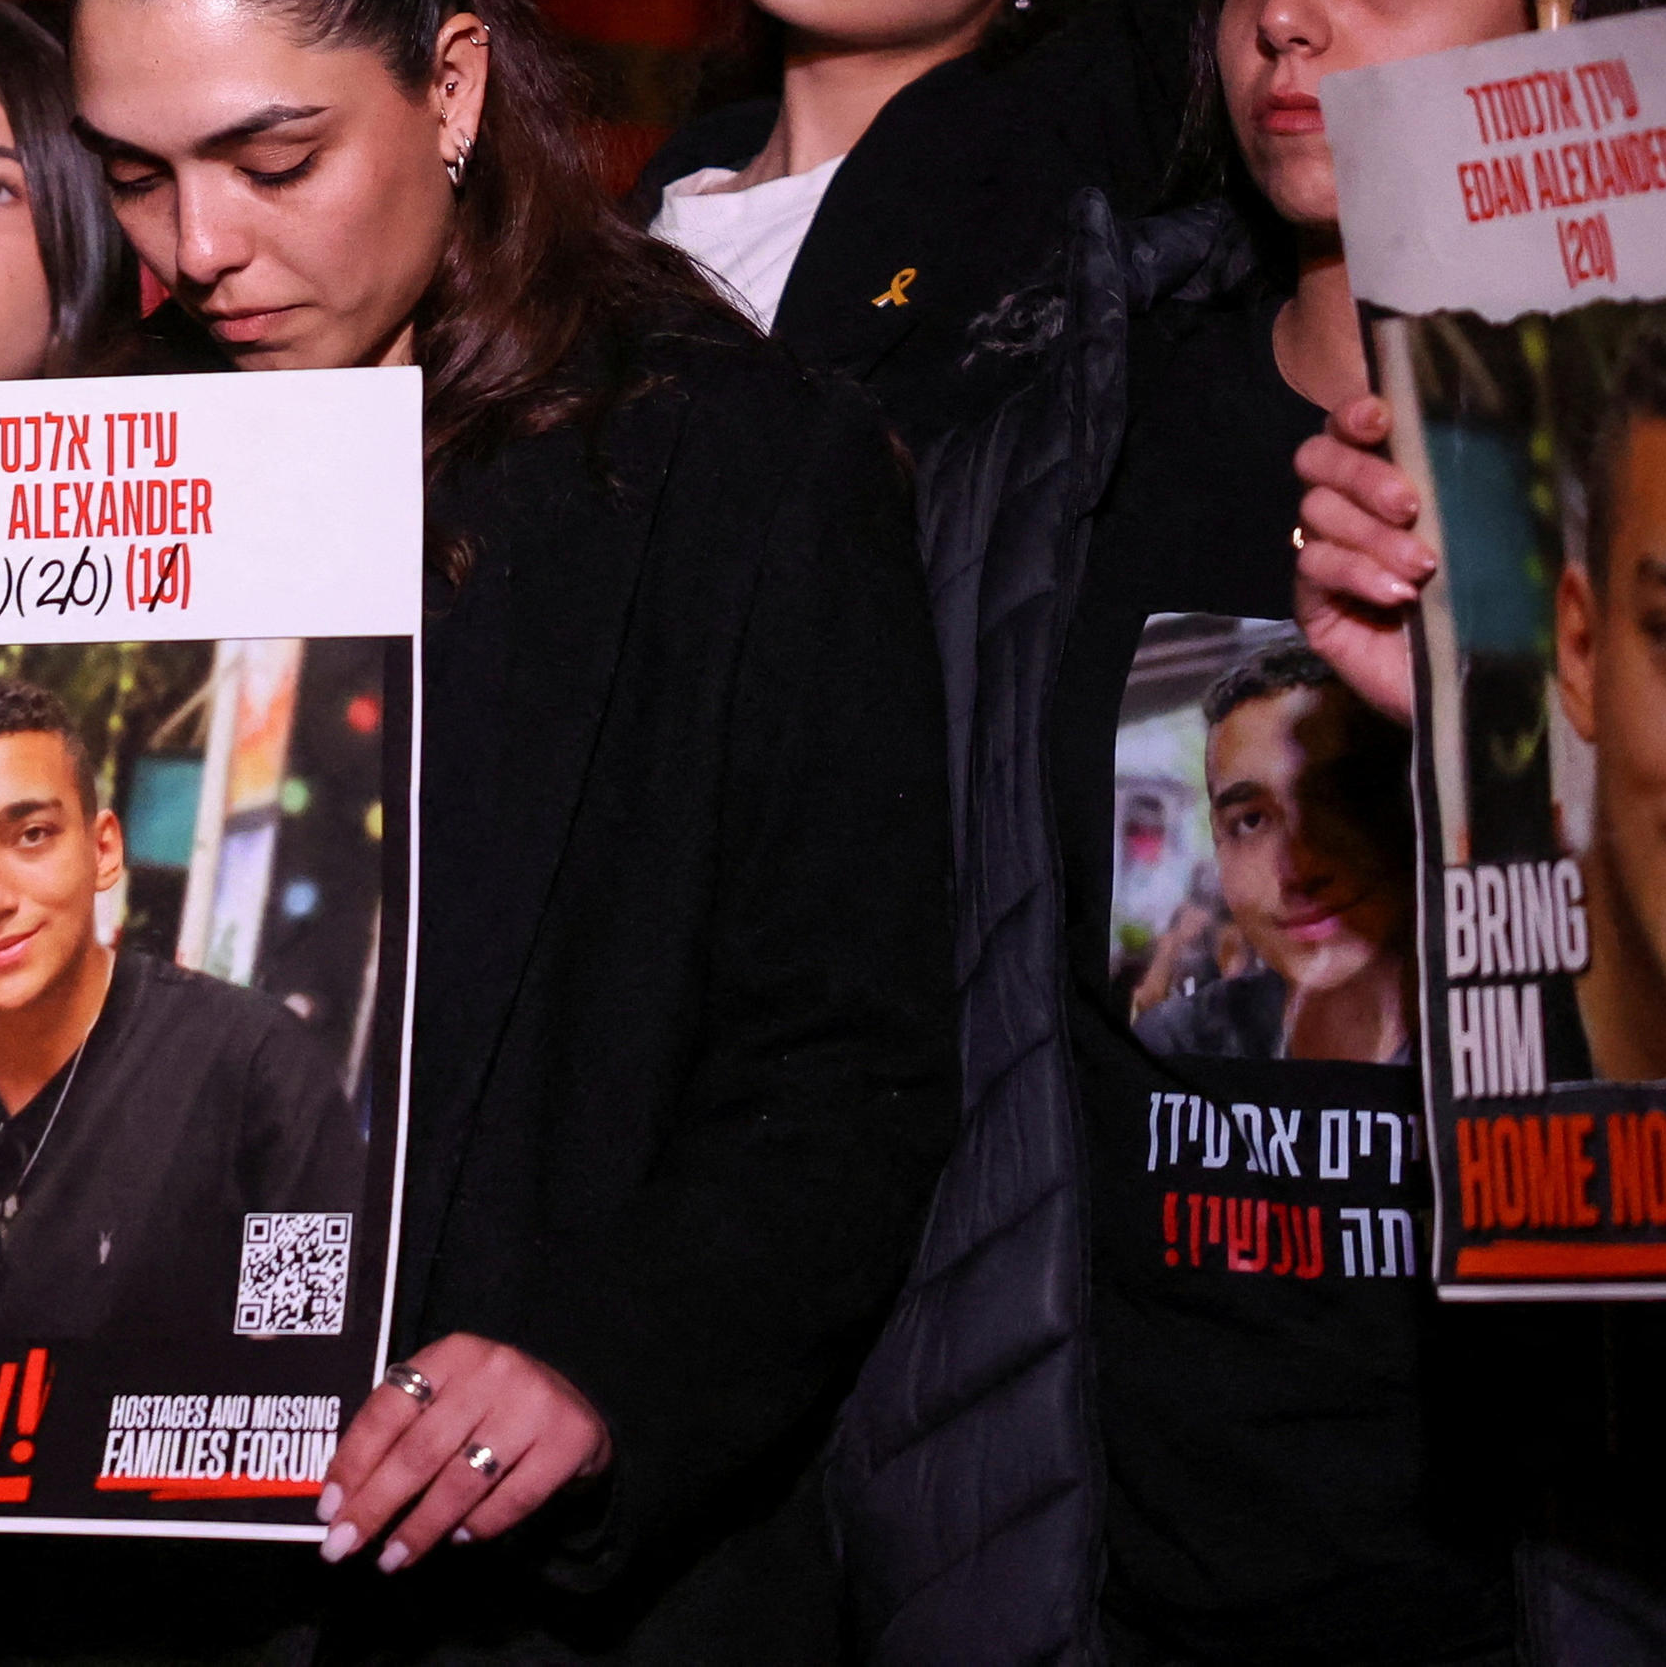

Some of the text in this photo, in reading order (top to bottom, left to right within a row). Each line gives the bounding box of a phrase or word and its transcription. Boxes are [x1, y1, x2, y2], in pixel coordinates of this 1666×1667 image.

[1457, 153, 1533, 224] EDAN
[1556, 212, 1617, 289] (20)
[104, 411, 178, 477] עידן
[8, 477, 213, 541] ALEXANDER
[1444, 856, 1589, 978] BRING
[1446, 983, 1547, 1099] HIM
[1147, 1091, 1231, 1172] עידן
[1231, 1102, 1302, 1178] את
[1456, 1113, 1600, 1229] HOME
[109, 1394, 341, 1431] HOSTAGES AND MISSING
[100, 1429, 338, 1483] FAMILIES FORUM
